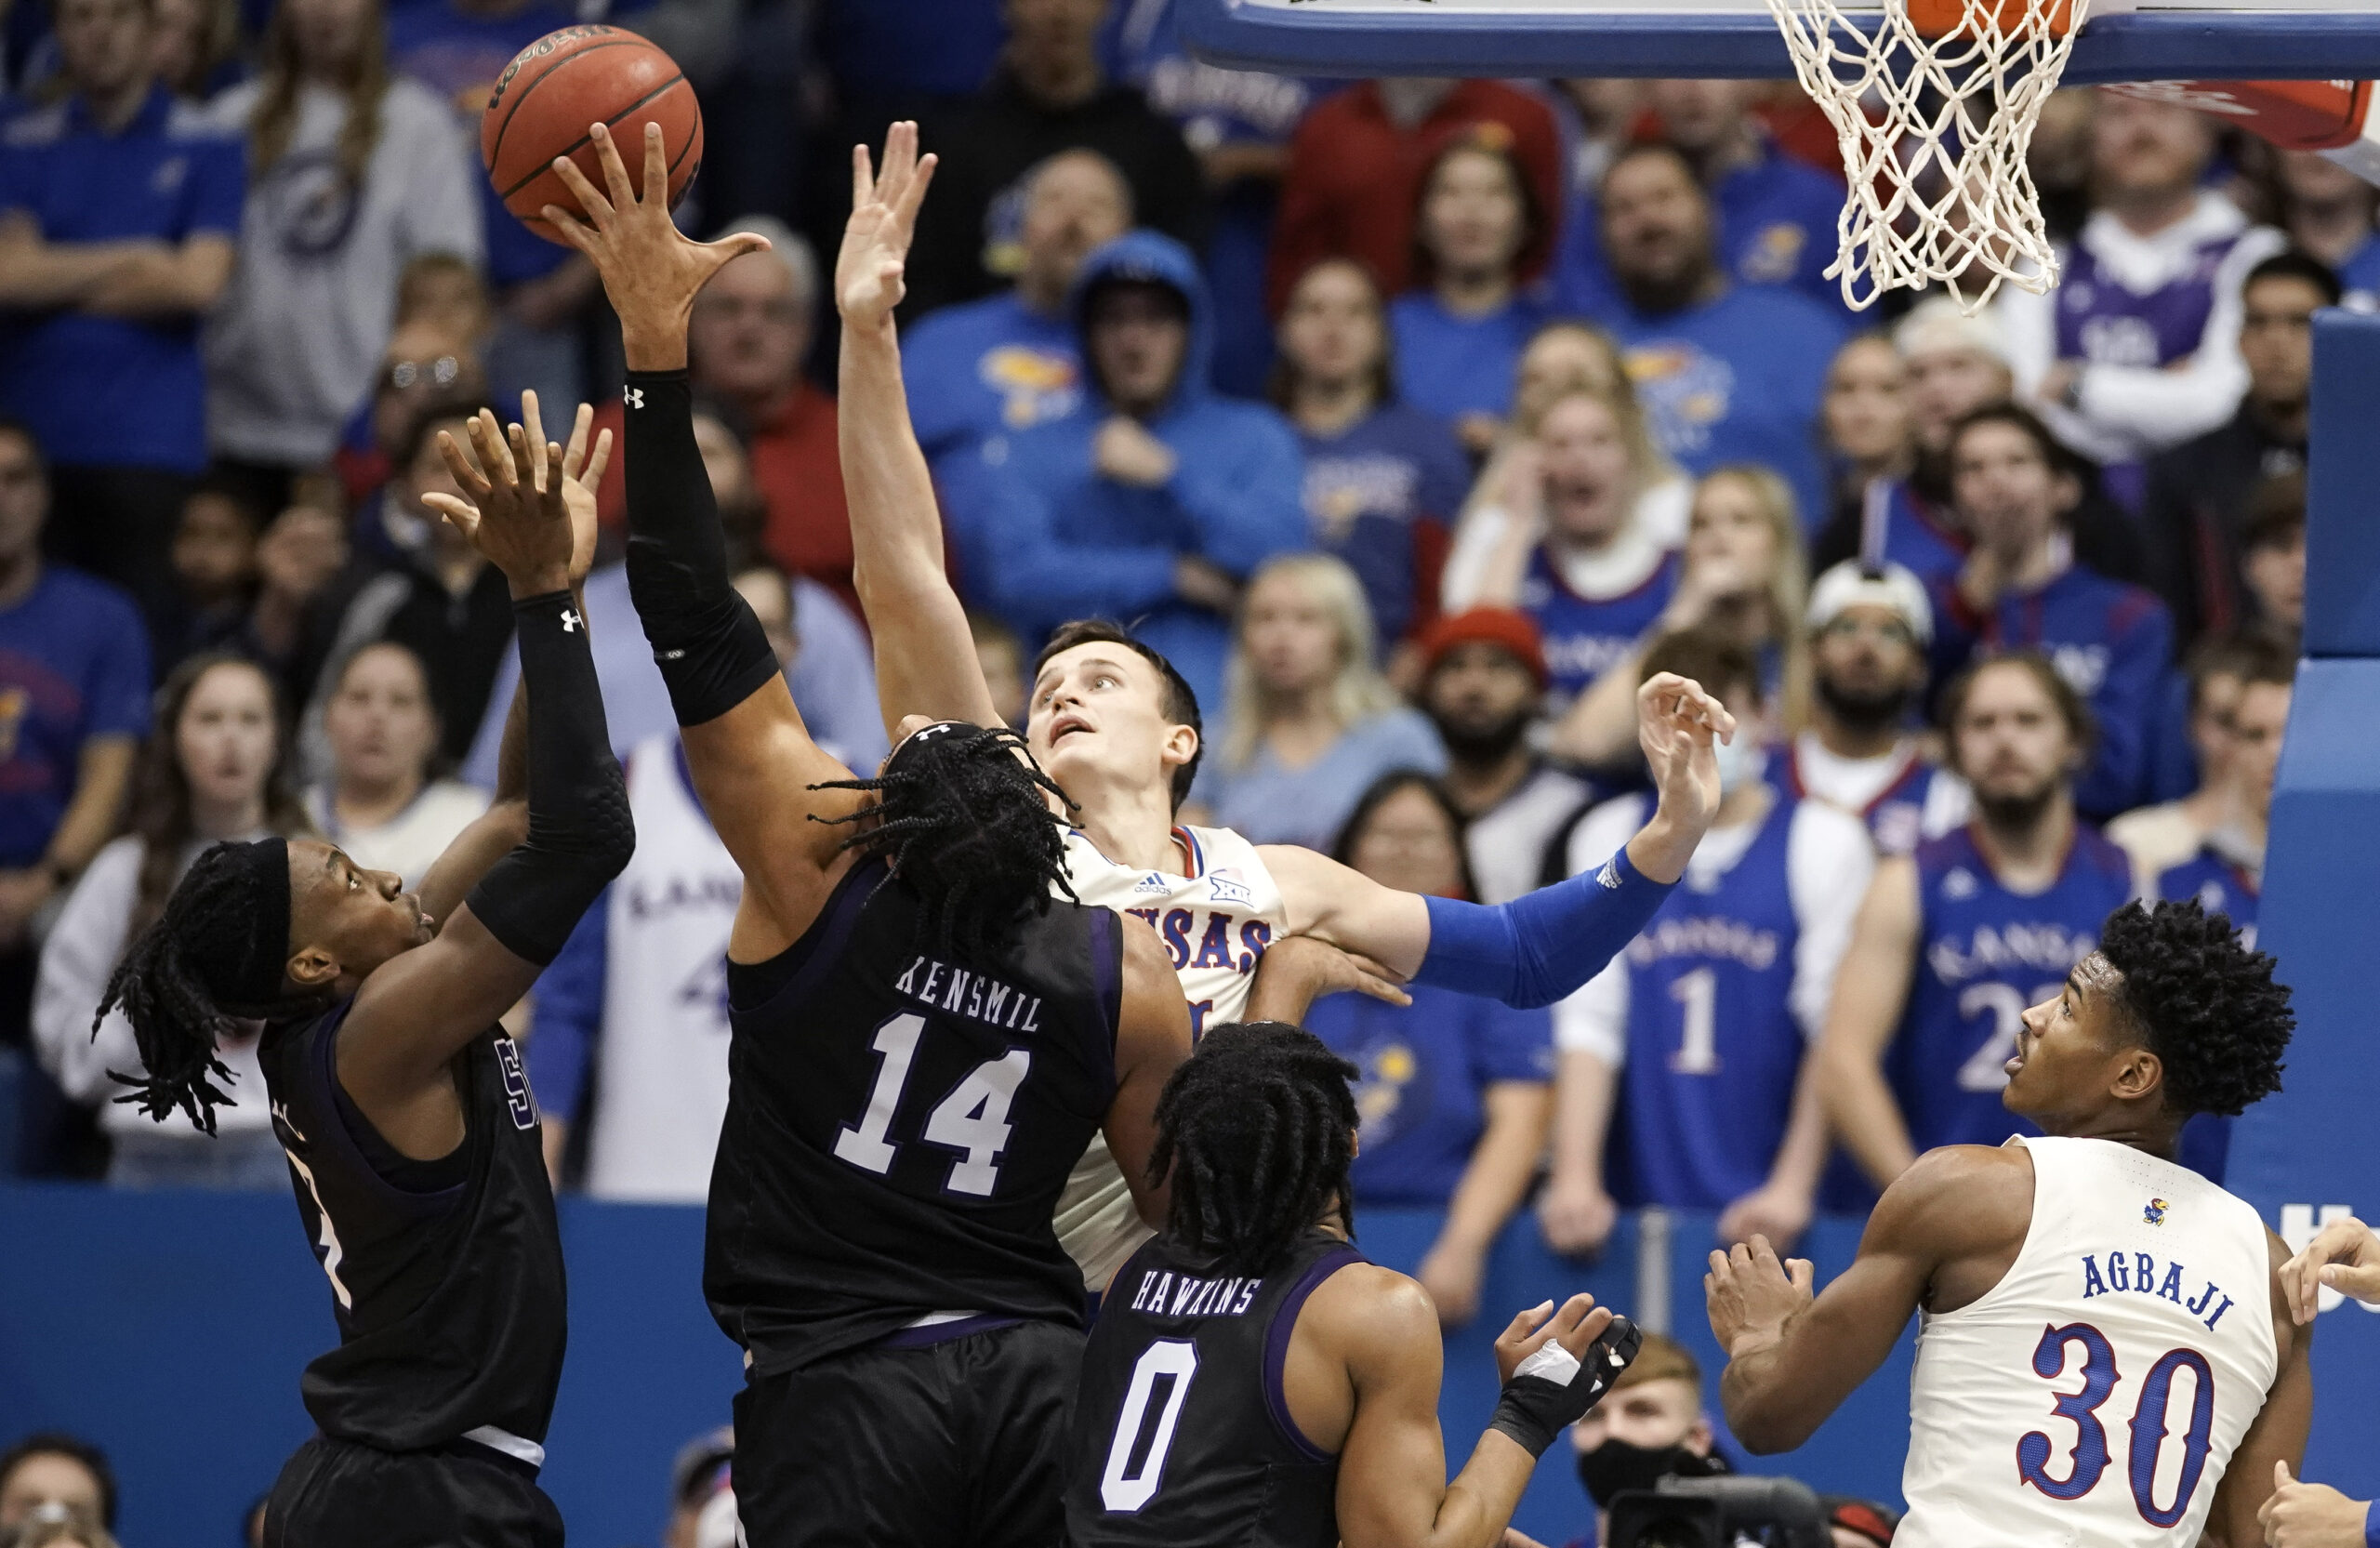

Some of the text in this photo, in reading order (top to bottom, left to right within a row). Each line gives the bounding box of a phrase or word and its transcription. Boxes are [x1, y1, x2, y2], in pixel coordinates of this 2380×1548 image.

[1133, 884, 1172, 895] adidas
[895, 955, 1041, 1033] KENSMIL
[1670, 967, 1724, 1075] 1
[833, 1012, 1031, 1197] 14
[1130, 1270, 1263, 1316] HAWKINS
[2082, 1250, 2235, 1332] AGBAJI
[1100, 1337, 1200, 1515] 0
[2016, 1322, 2215, 1528] 30
